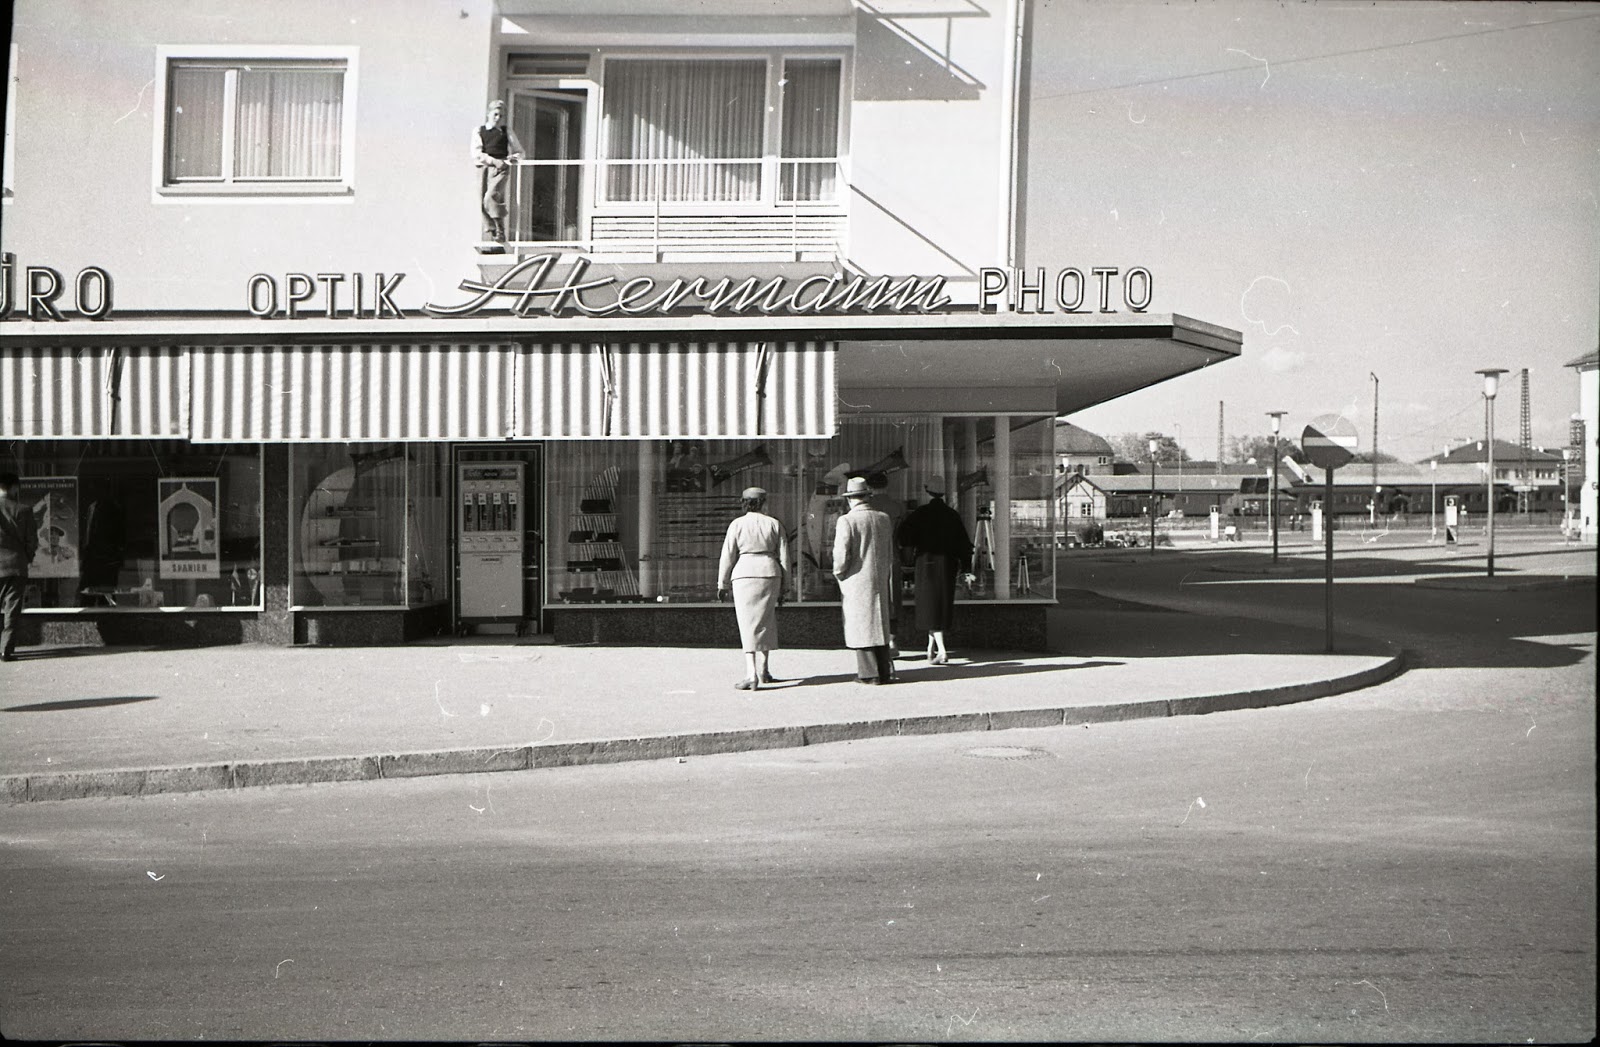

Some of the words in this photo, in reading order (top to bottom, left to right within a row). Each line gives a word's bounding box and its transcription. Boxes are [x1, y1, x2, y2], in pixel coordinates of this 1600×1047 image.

[247, 273, 405, 319] OPTIK
[421, 252, 952, 318] Akermann
[979, 266, 1153, 314] PHOTO
